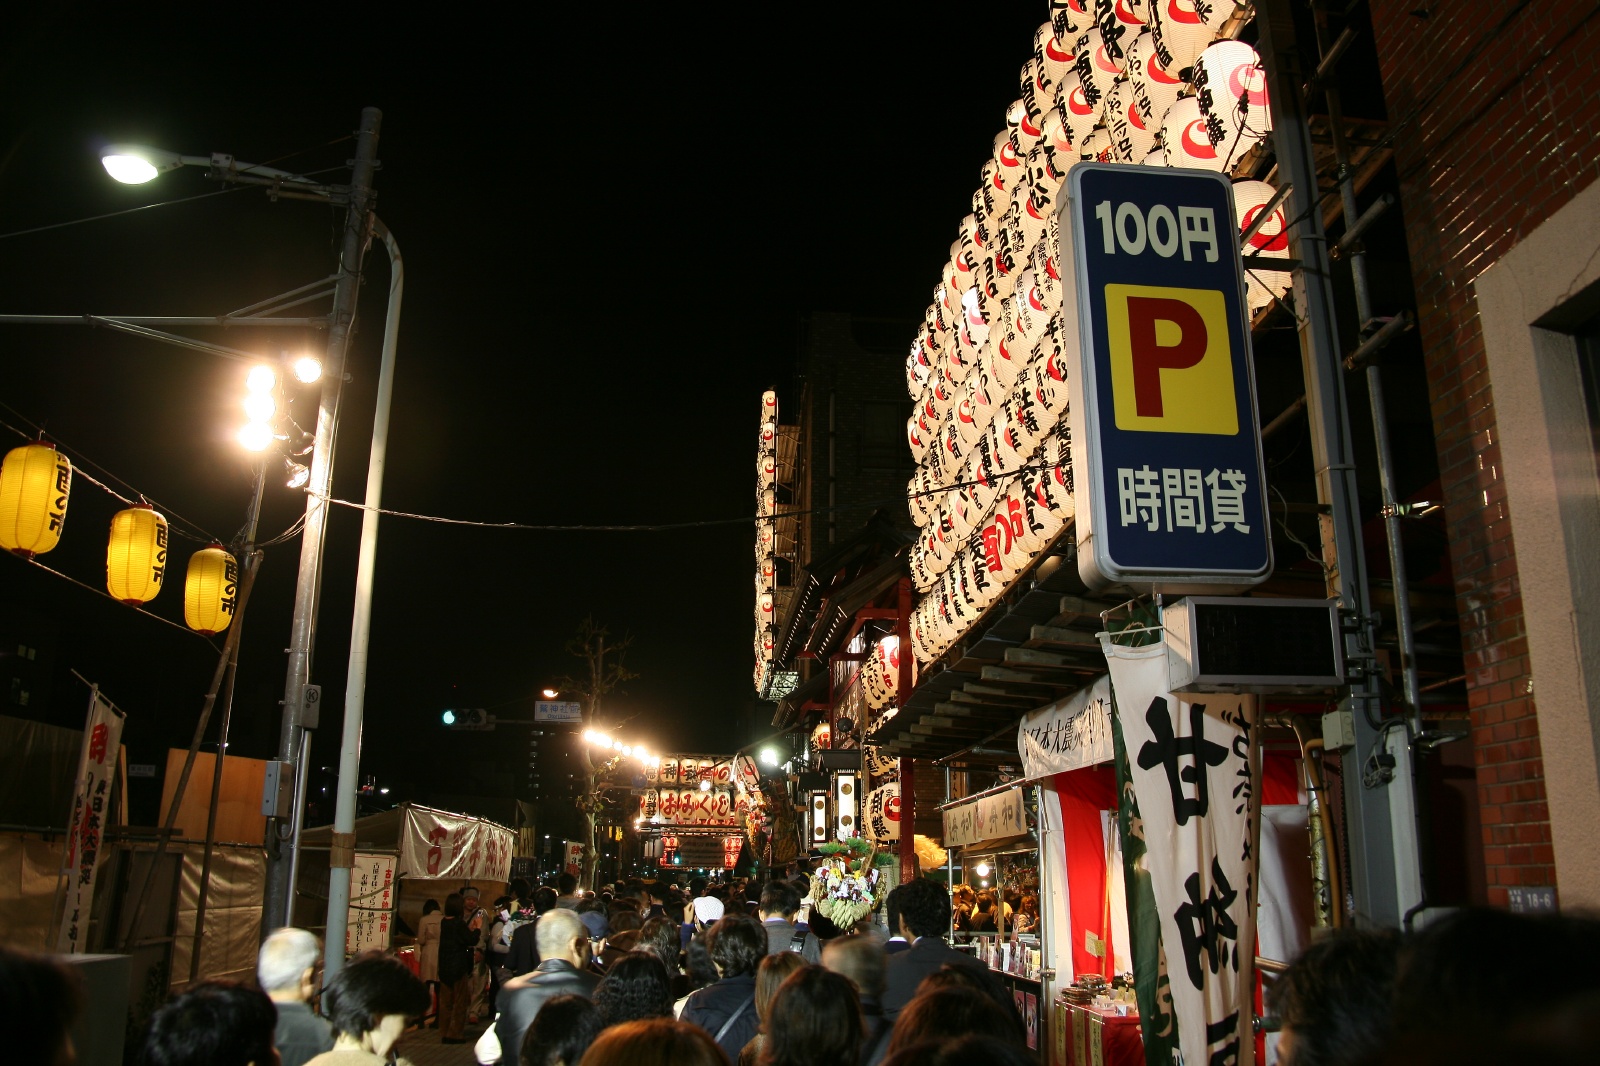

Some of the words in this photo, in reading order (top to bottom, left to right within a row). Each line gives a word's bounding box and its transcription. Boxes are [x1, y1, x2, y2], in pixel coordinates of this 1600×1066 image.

[1095, 200, 1219, 263] 100円
[1126, 296, 1208, 418] P
[1117, 465, 1250, 534] 時間貸
